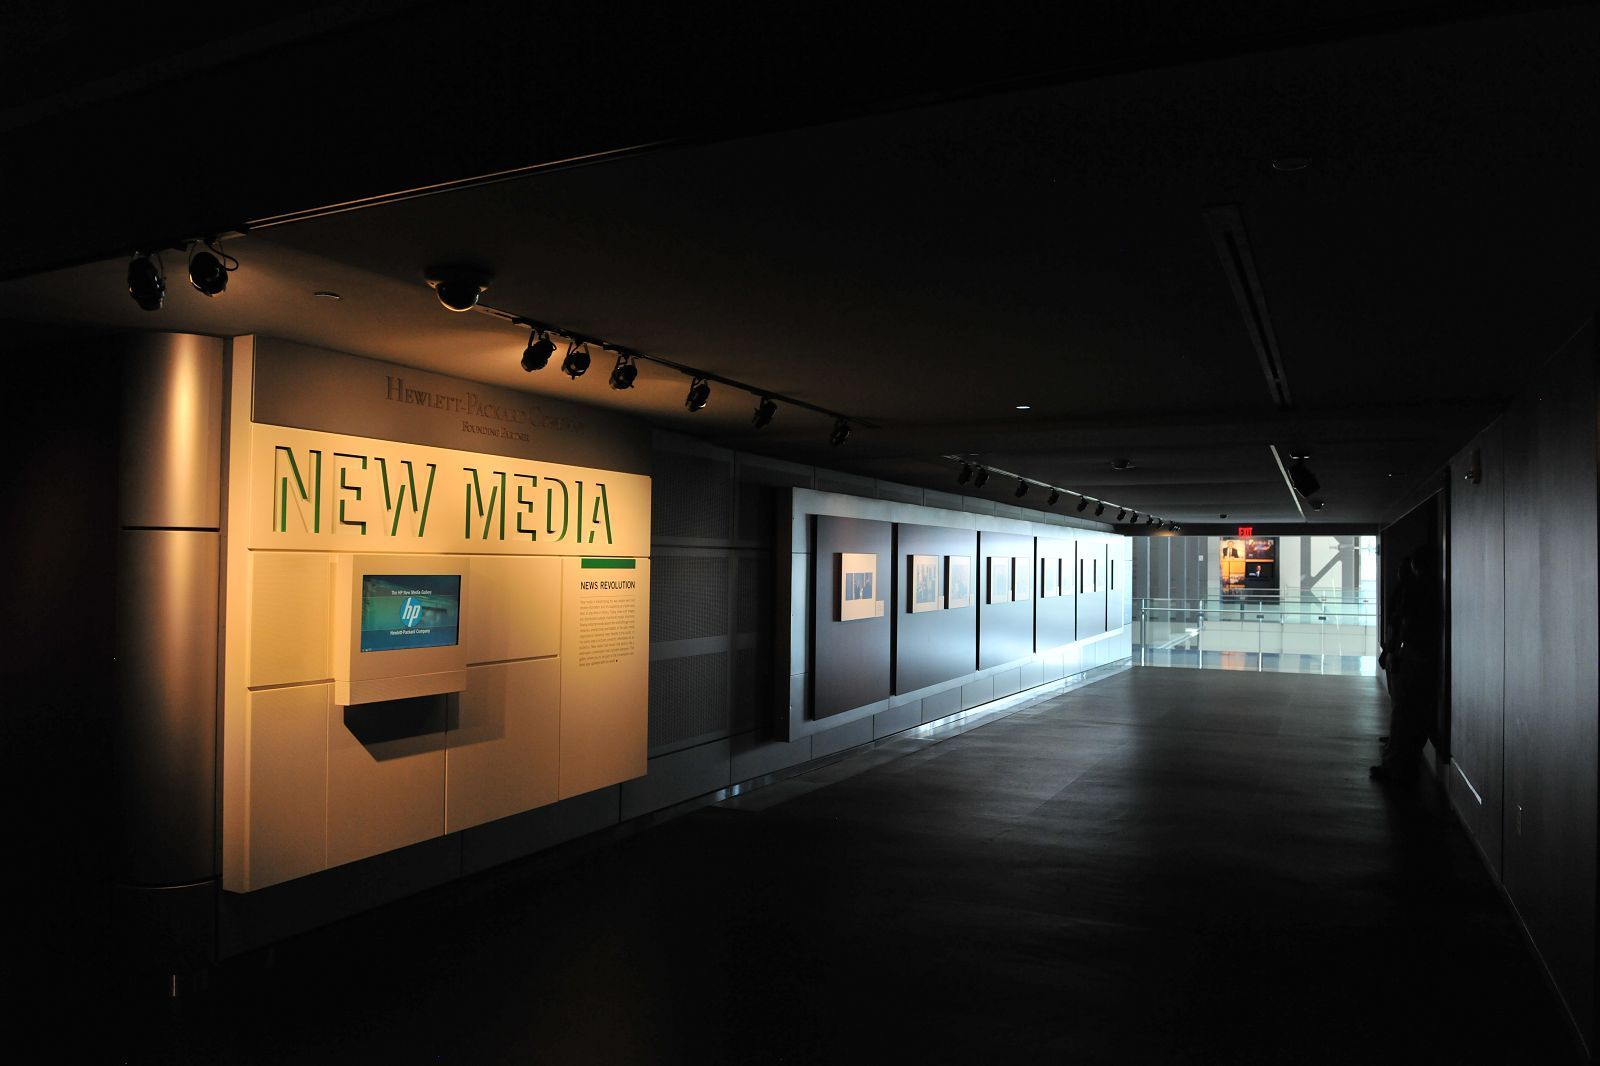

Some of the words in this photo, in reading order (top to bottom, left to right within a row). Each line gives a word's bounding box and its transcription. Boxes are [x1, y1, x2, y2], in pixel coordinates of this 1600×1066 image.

[273, 445, 437, 538] NEW
[463, 467, 613, 545] MEDIA
[1238, 526, 1253, 537] EXIT
[580, 581, 599, 590] NEWS
[600, 581, 636, 590] REVOLUTION
[402, 597, 421, 628] hp
